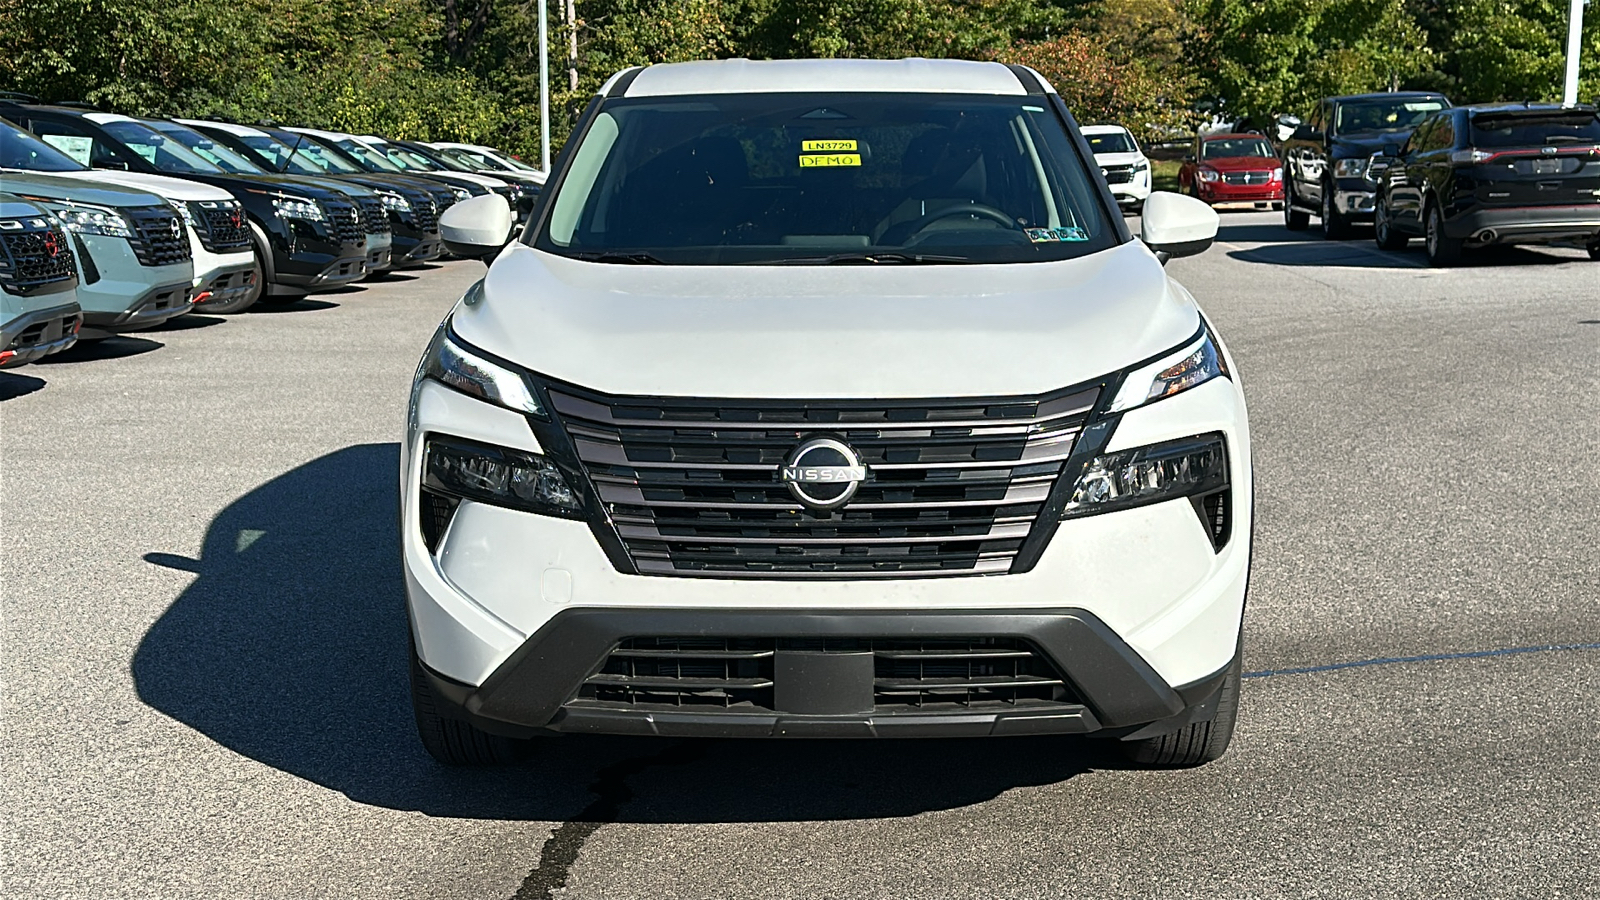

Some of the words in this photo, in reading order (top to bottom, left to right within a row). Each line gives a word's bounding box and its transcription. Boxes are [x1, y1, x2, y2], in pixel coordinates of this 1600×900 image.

[808, 142, 852, 150] LN3729
[801, 156, 853, 165] DEMO
[783, 468, 863, 480] NISSAN
